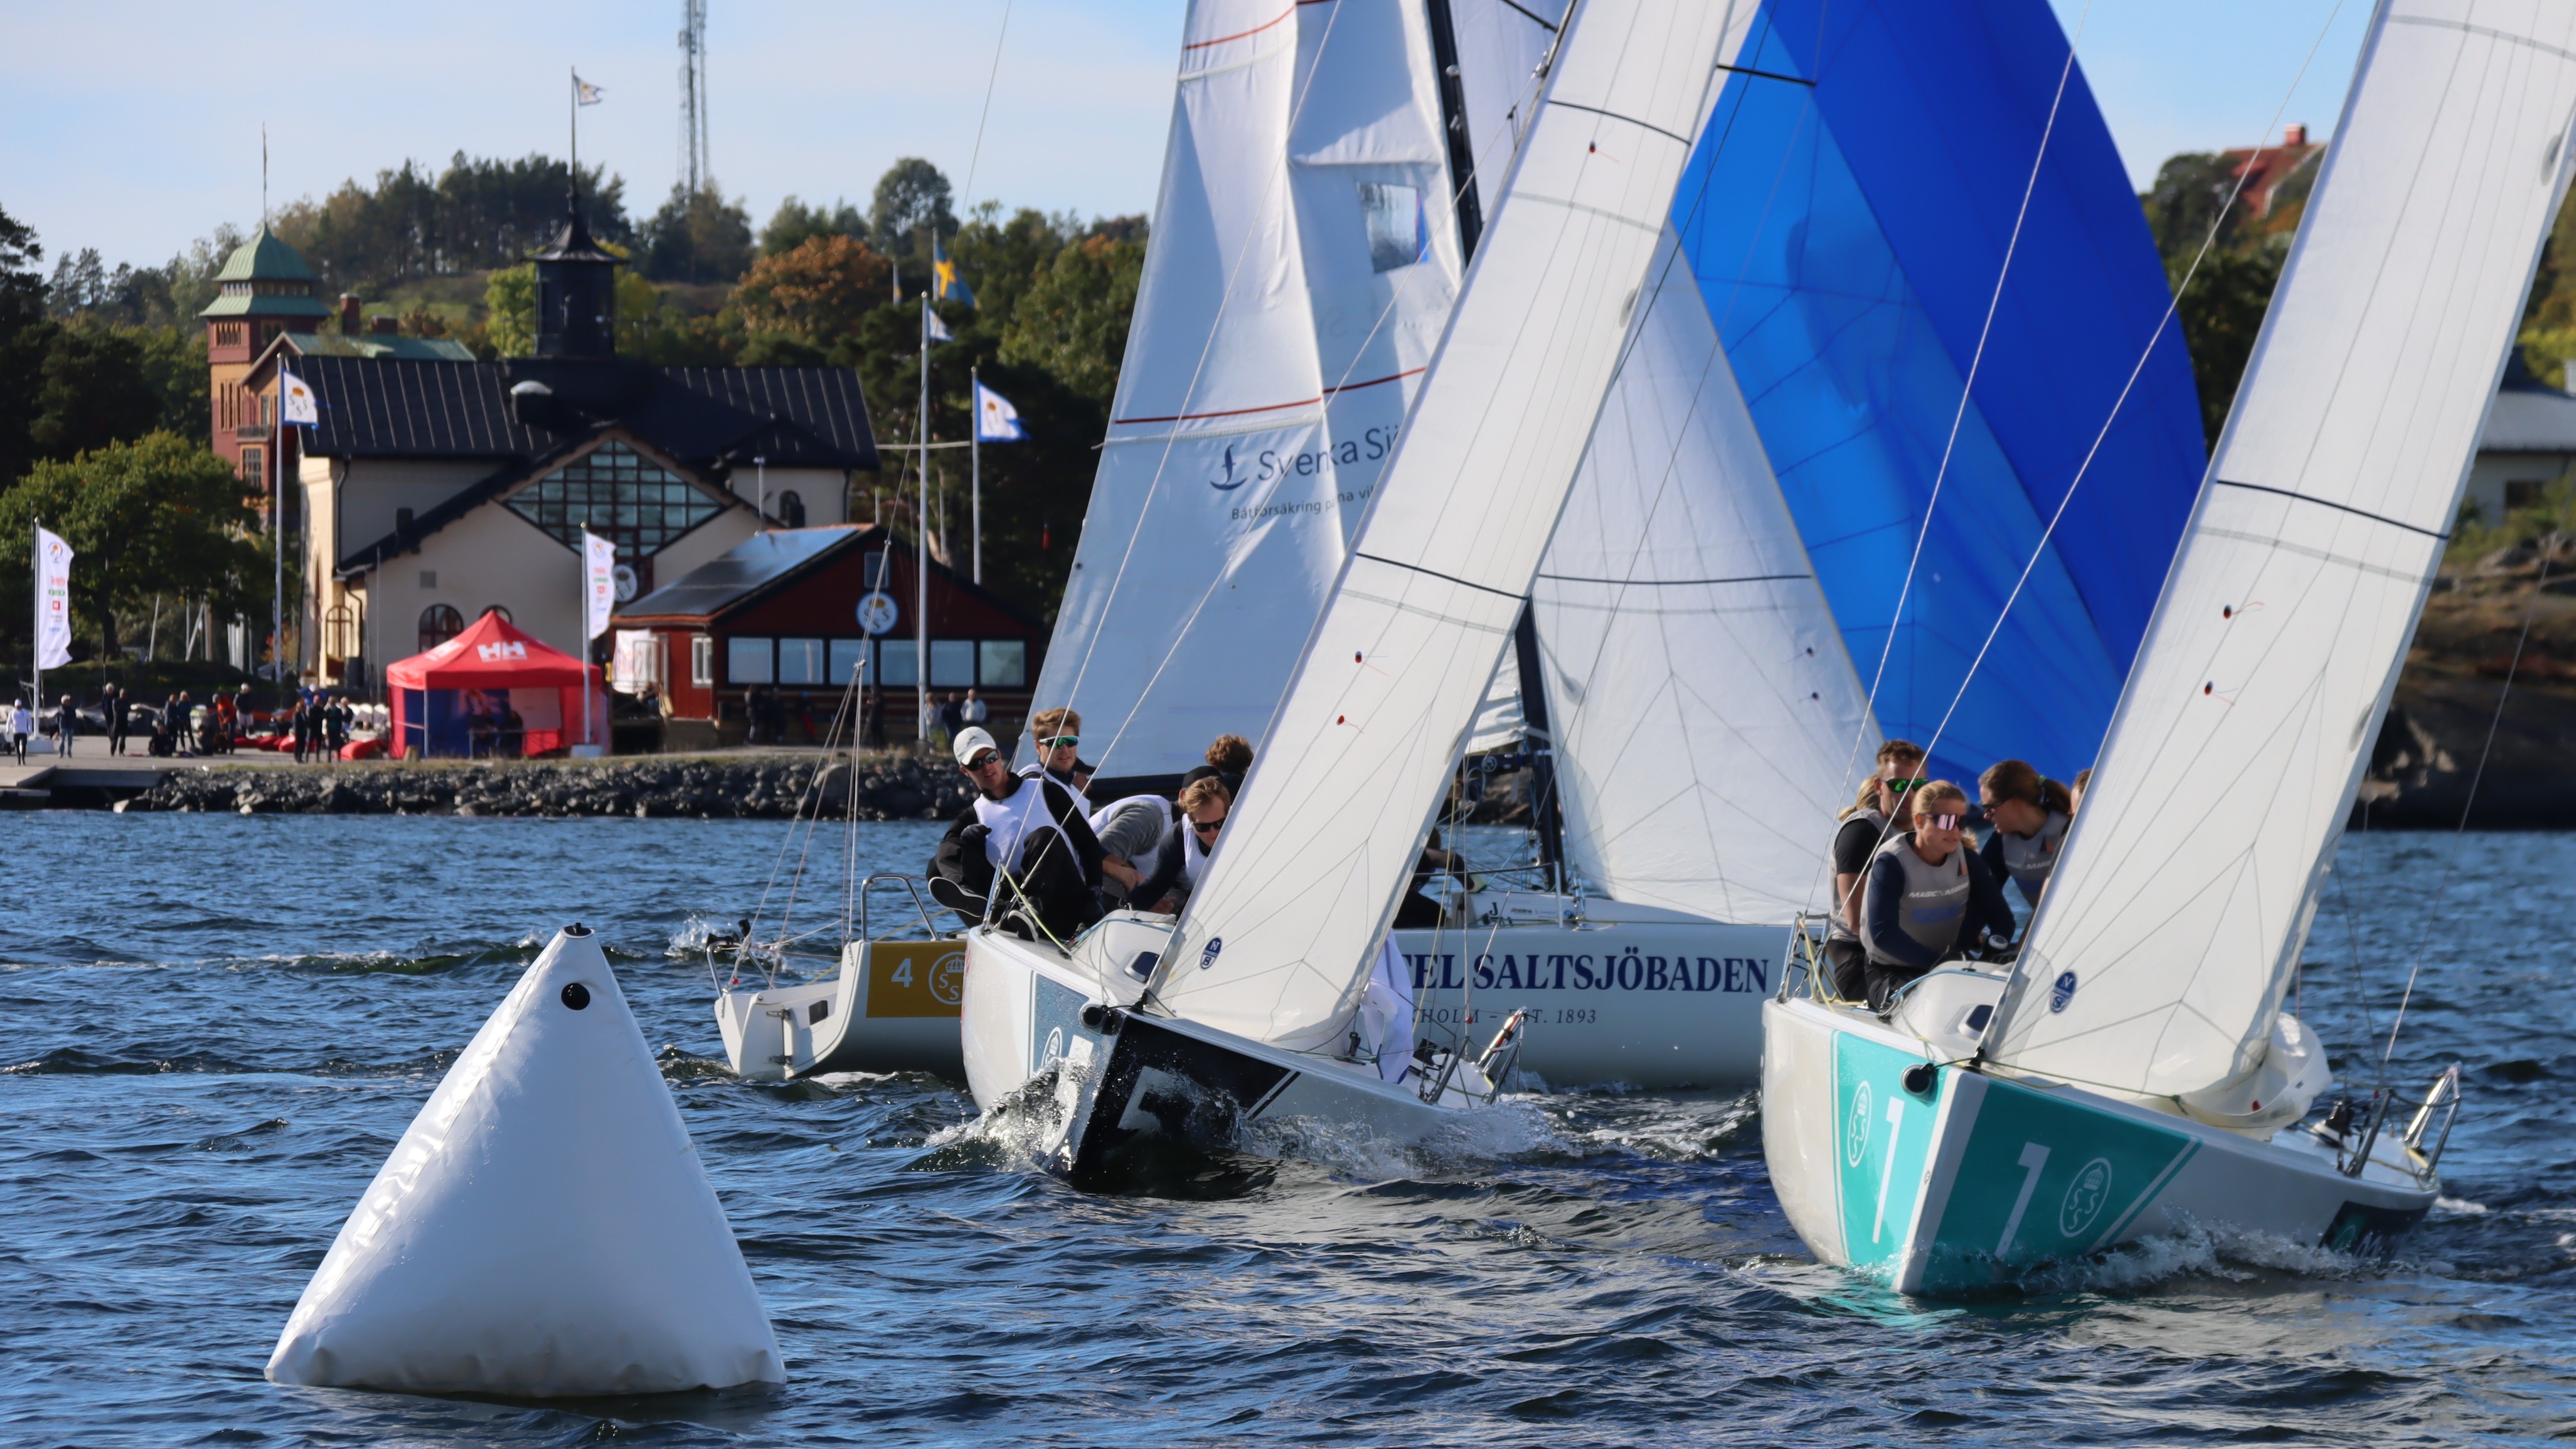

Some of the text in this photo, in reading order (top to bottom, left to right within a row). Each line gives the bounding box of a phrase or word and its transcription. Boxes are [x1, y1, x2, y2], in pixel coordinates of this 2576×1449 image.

[1365, 425, 1398, 466] Sj
[891, 958, 913, 988] 4
[1472, 946, 1769, 994] SALTSJÖBADEN
[1556, 1010, 1596, 1024] 1893
[1871, 1096, 1905, 1244] 1
[1994, 1141, 2052, 1261] 1
